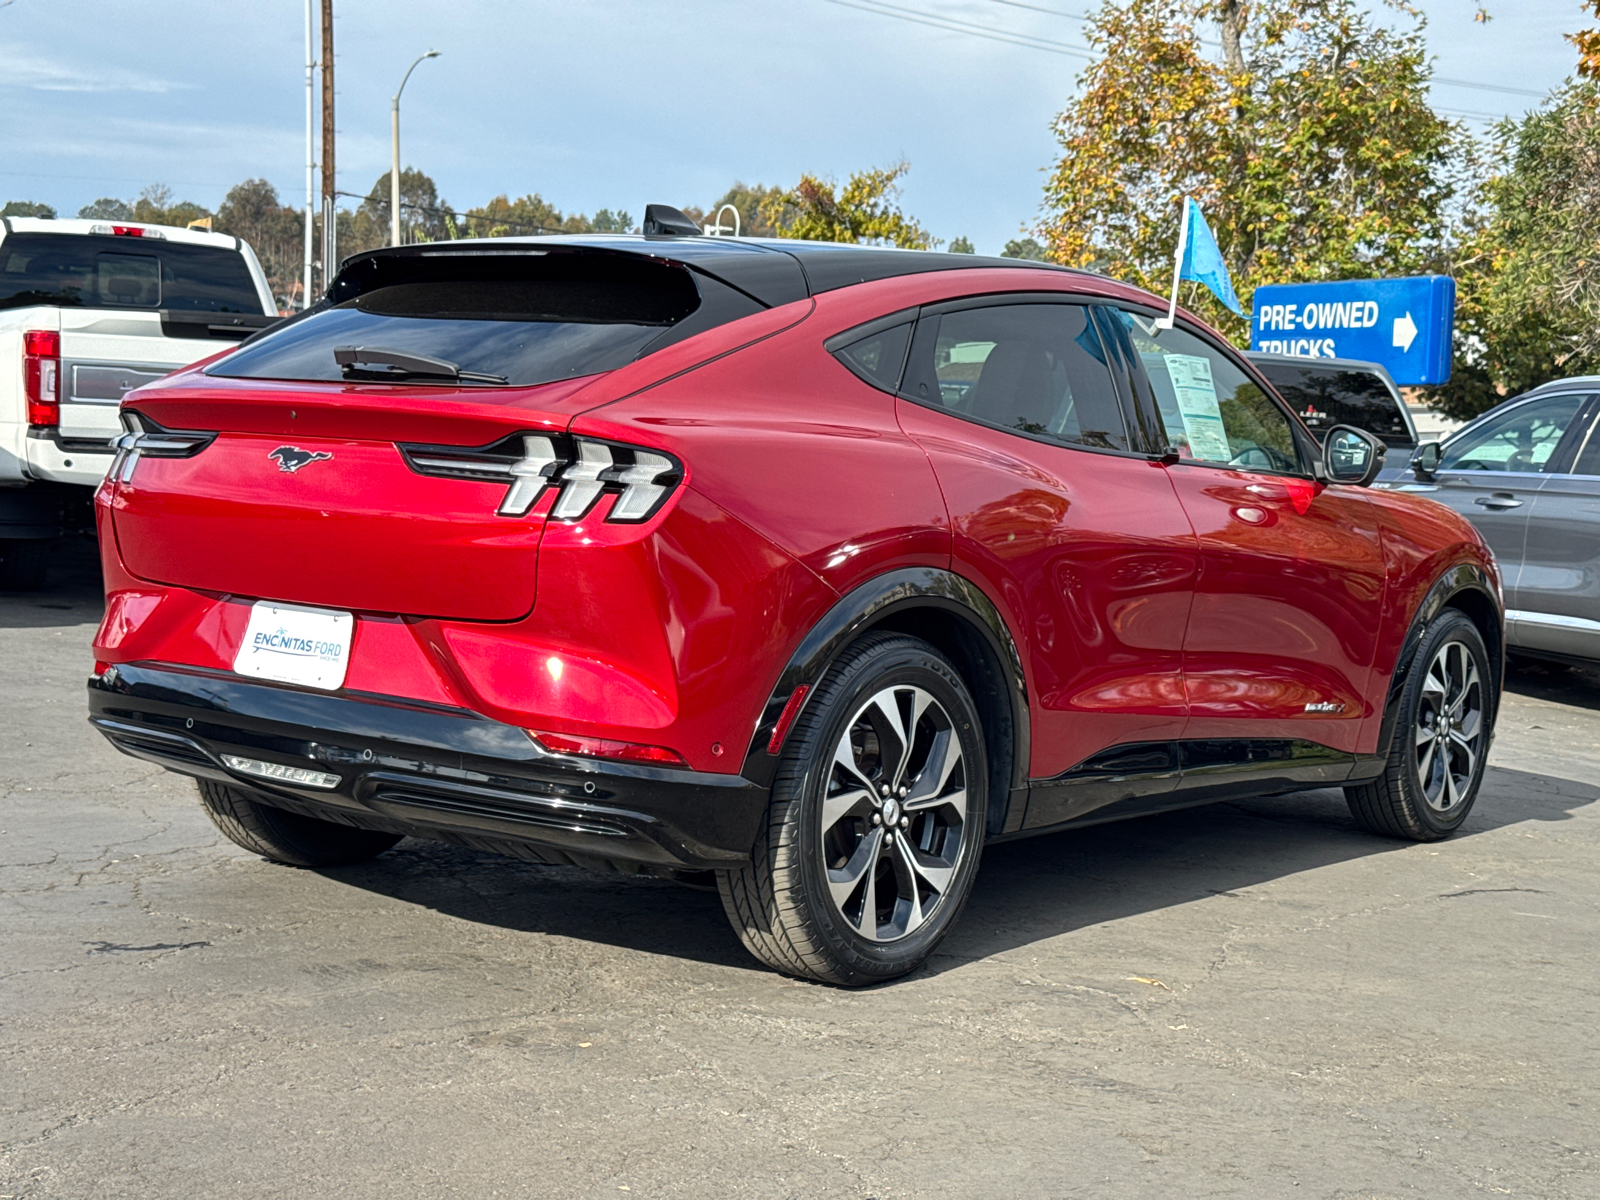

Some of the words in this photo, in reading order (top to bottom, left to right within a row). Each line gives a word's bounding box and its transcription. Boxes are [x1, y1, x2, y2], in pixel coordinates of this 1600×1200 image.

[1259, 301, 1379, 331] PRE-OWNED
[254, 632, 313, 652] ENCINITAS
[313, 640, 342, 657] FORD
[919, 656, 960, 689] TOYO
